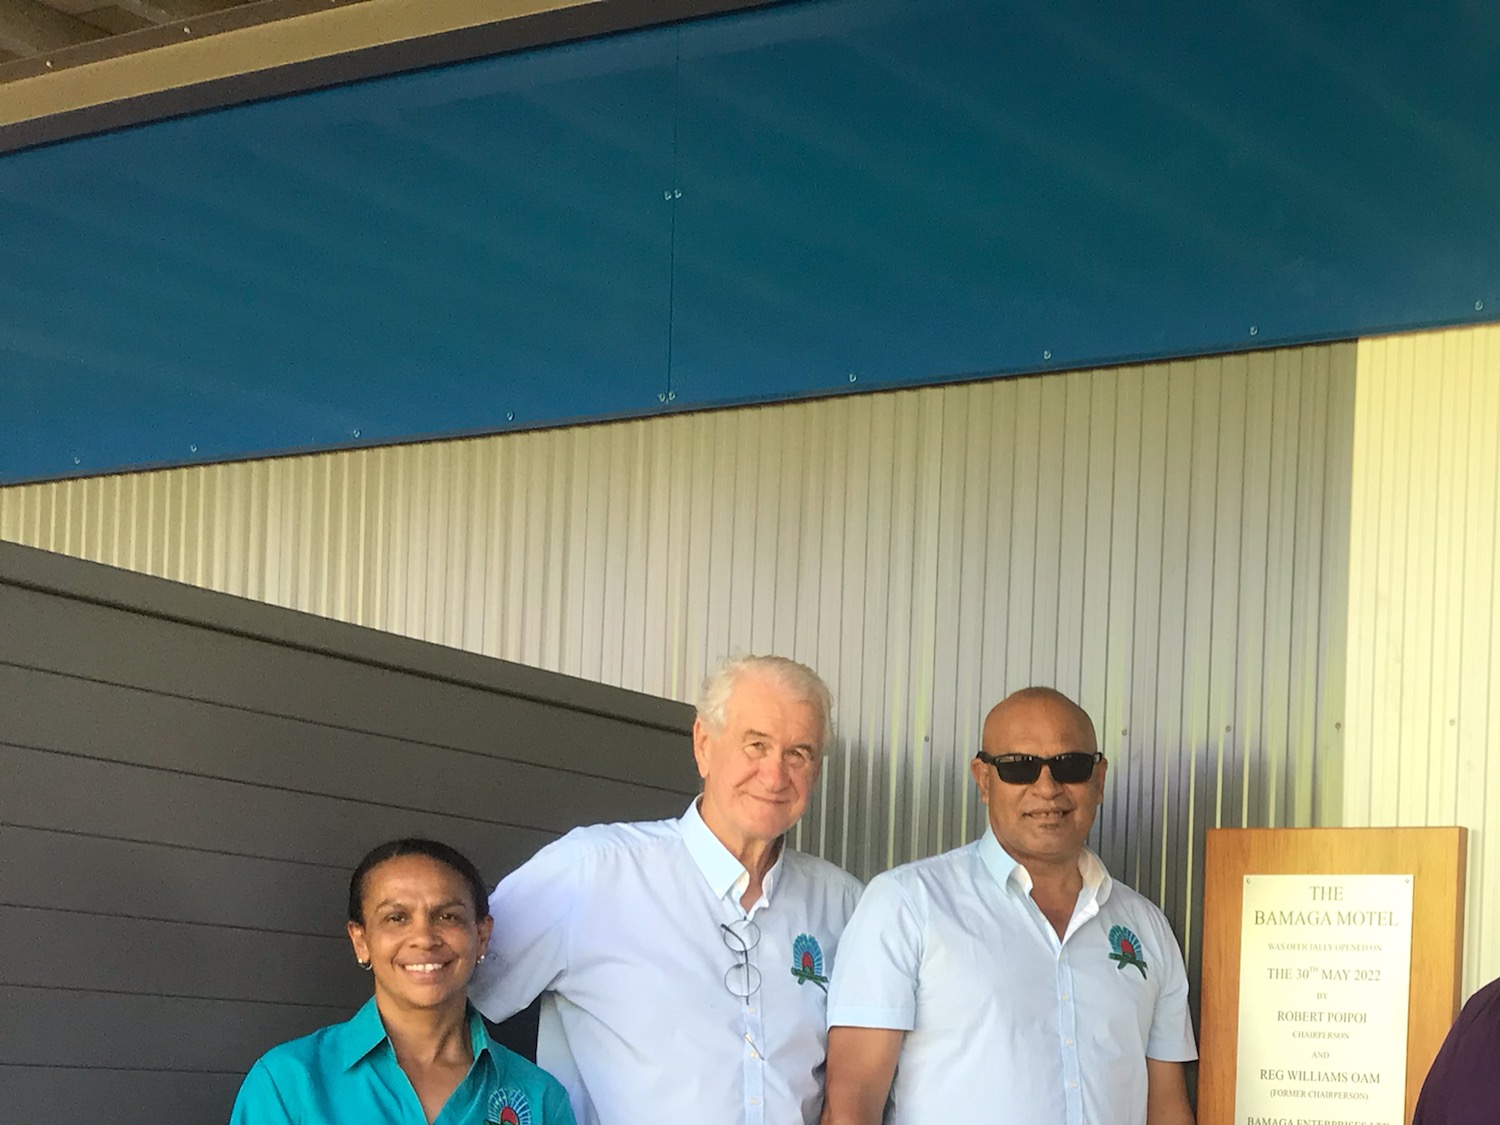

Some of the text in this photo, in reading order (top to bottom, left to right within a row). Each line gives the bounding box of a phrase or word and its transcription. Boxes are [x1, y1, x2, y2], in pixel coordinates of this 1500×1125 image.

[1309, 886, 1344, 901] THE
[1254, 910, 1399, 927] BAMAGA MOTEL
[1268, 943, 1285, 951] WAS
[1267, 967, 1293, 980] THE
[1321, 968, 1350, 981] MAY
[1354, 969, 1381, 981] 2022
[1316, 992, 1328, 1000] BY
[1277, 1010, 1367, 1024] ROBERT POIPOI
[1292, 1030, 1350, 1040] CHAIRPERSON
[1311, 1051, 1330, 1059] AND
[1260, 1069, 1380, 1084] REG WILLIAMS OAM
[1269, 1088, 1369, 1101] (FORMER CHAIRPERSON)
